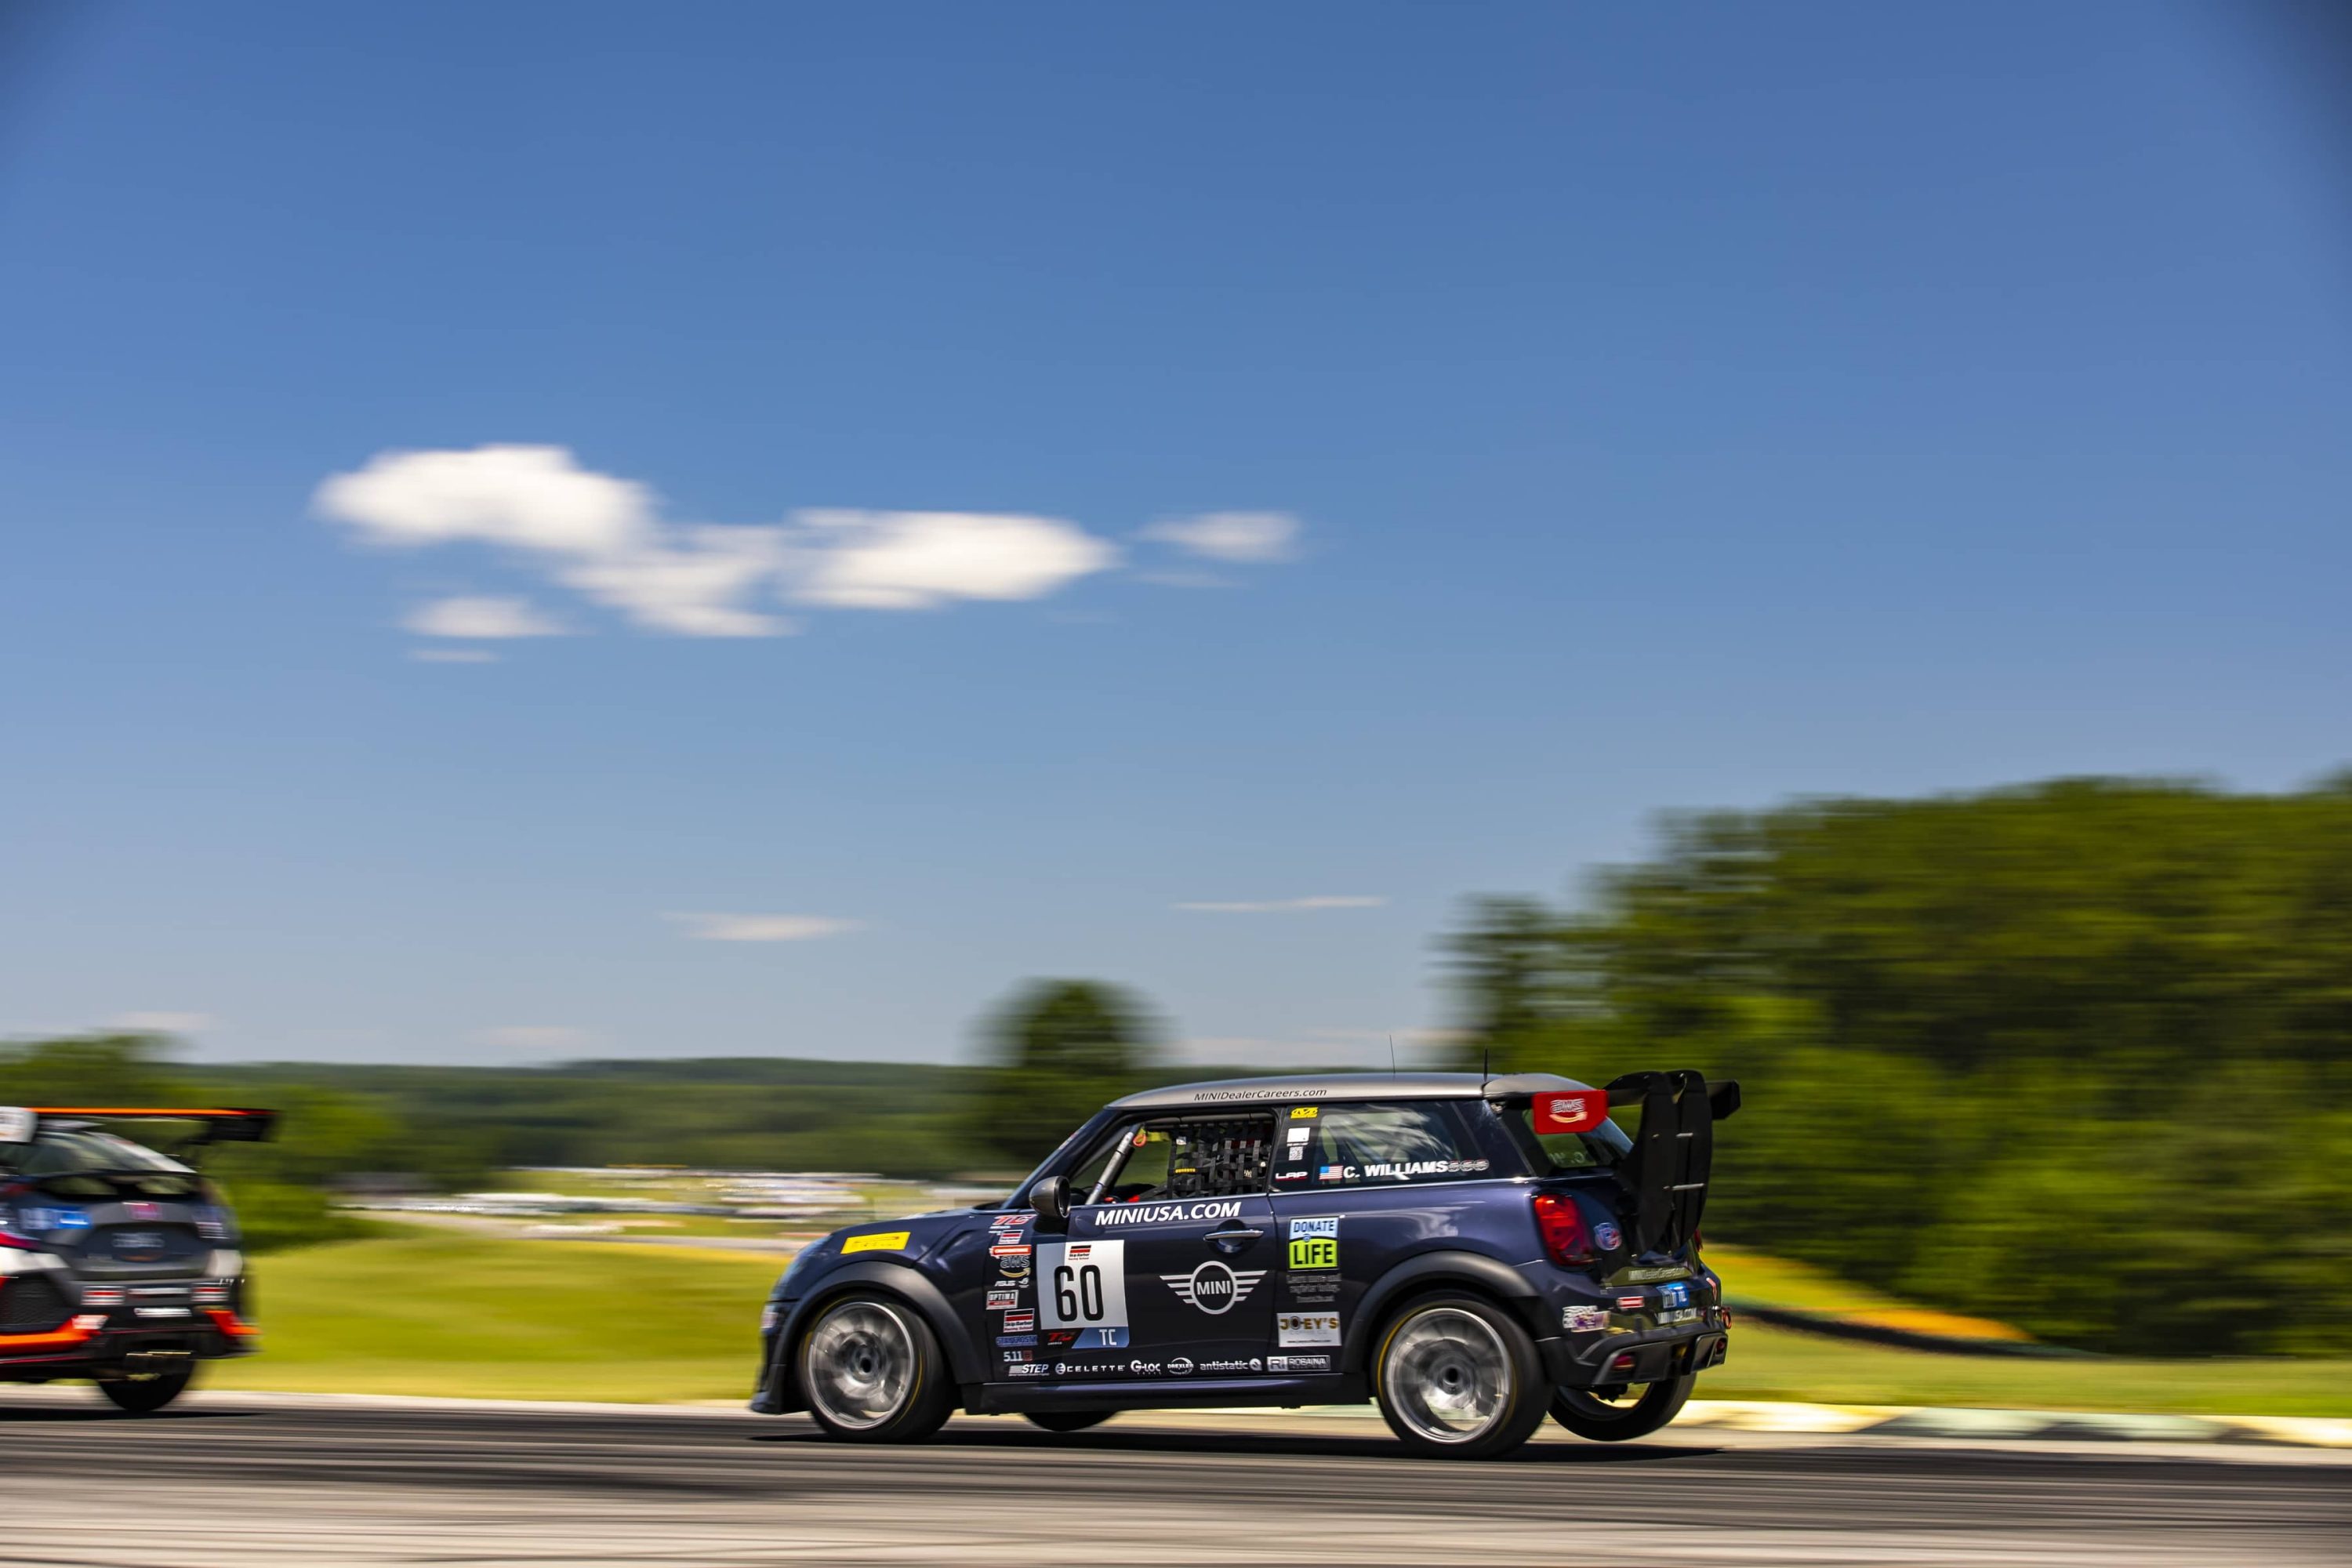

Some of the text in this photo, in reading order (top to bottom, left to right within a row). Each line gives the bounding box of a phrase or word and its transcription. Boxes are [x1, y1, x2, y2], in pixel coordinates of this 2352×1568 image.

[1194, 1088, 1327, 1102] MINIDealerCareers.com
[1550, 1098, 1585, 1113] aws
[1343, 1166, 1361, 1178] C.
[1364, 1160, 1449, 1178] WILLIAMS
[1095, 1201, 1242, 1226] MINIUSA.COM
[1294, 1220, 1335, 1233] DONATE
[1294, 1243, 1334, 1265] LIFE
[1000, 1255, 1030, 1269] aws
[1054, 1265, 1105, 1323] 60
[1196, 1279, 1232, 1296] MINI
[988, 1293, 1015, 1301] OPTIMA
[1279, 1316, 1340, 1330] JOEY'S
[1098, 1328, 1117, 1347] TC
[1022, 1363, 1049, 1374] STEP
[1130, 1359, 1161, 1373] G-LOC
[1200, 1359, 1249, 1370] antistatic
